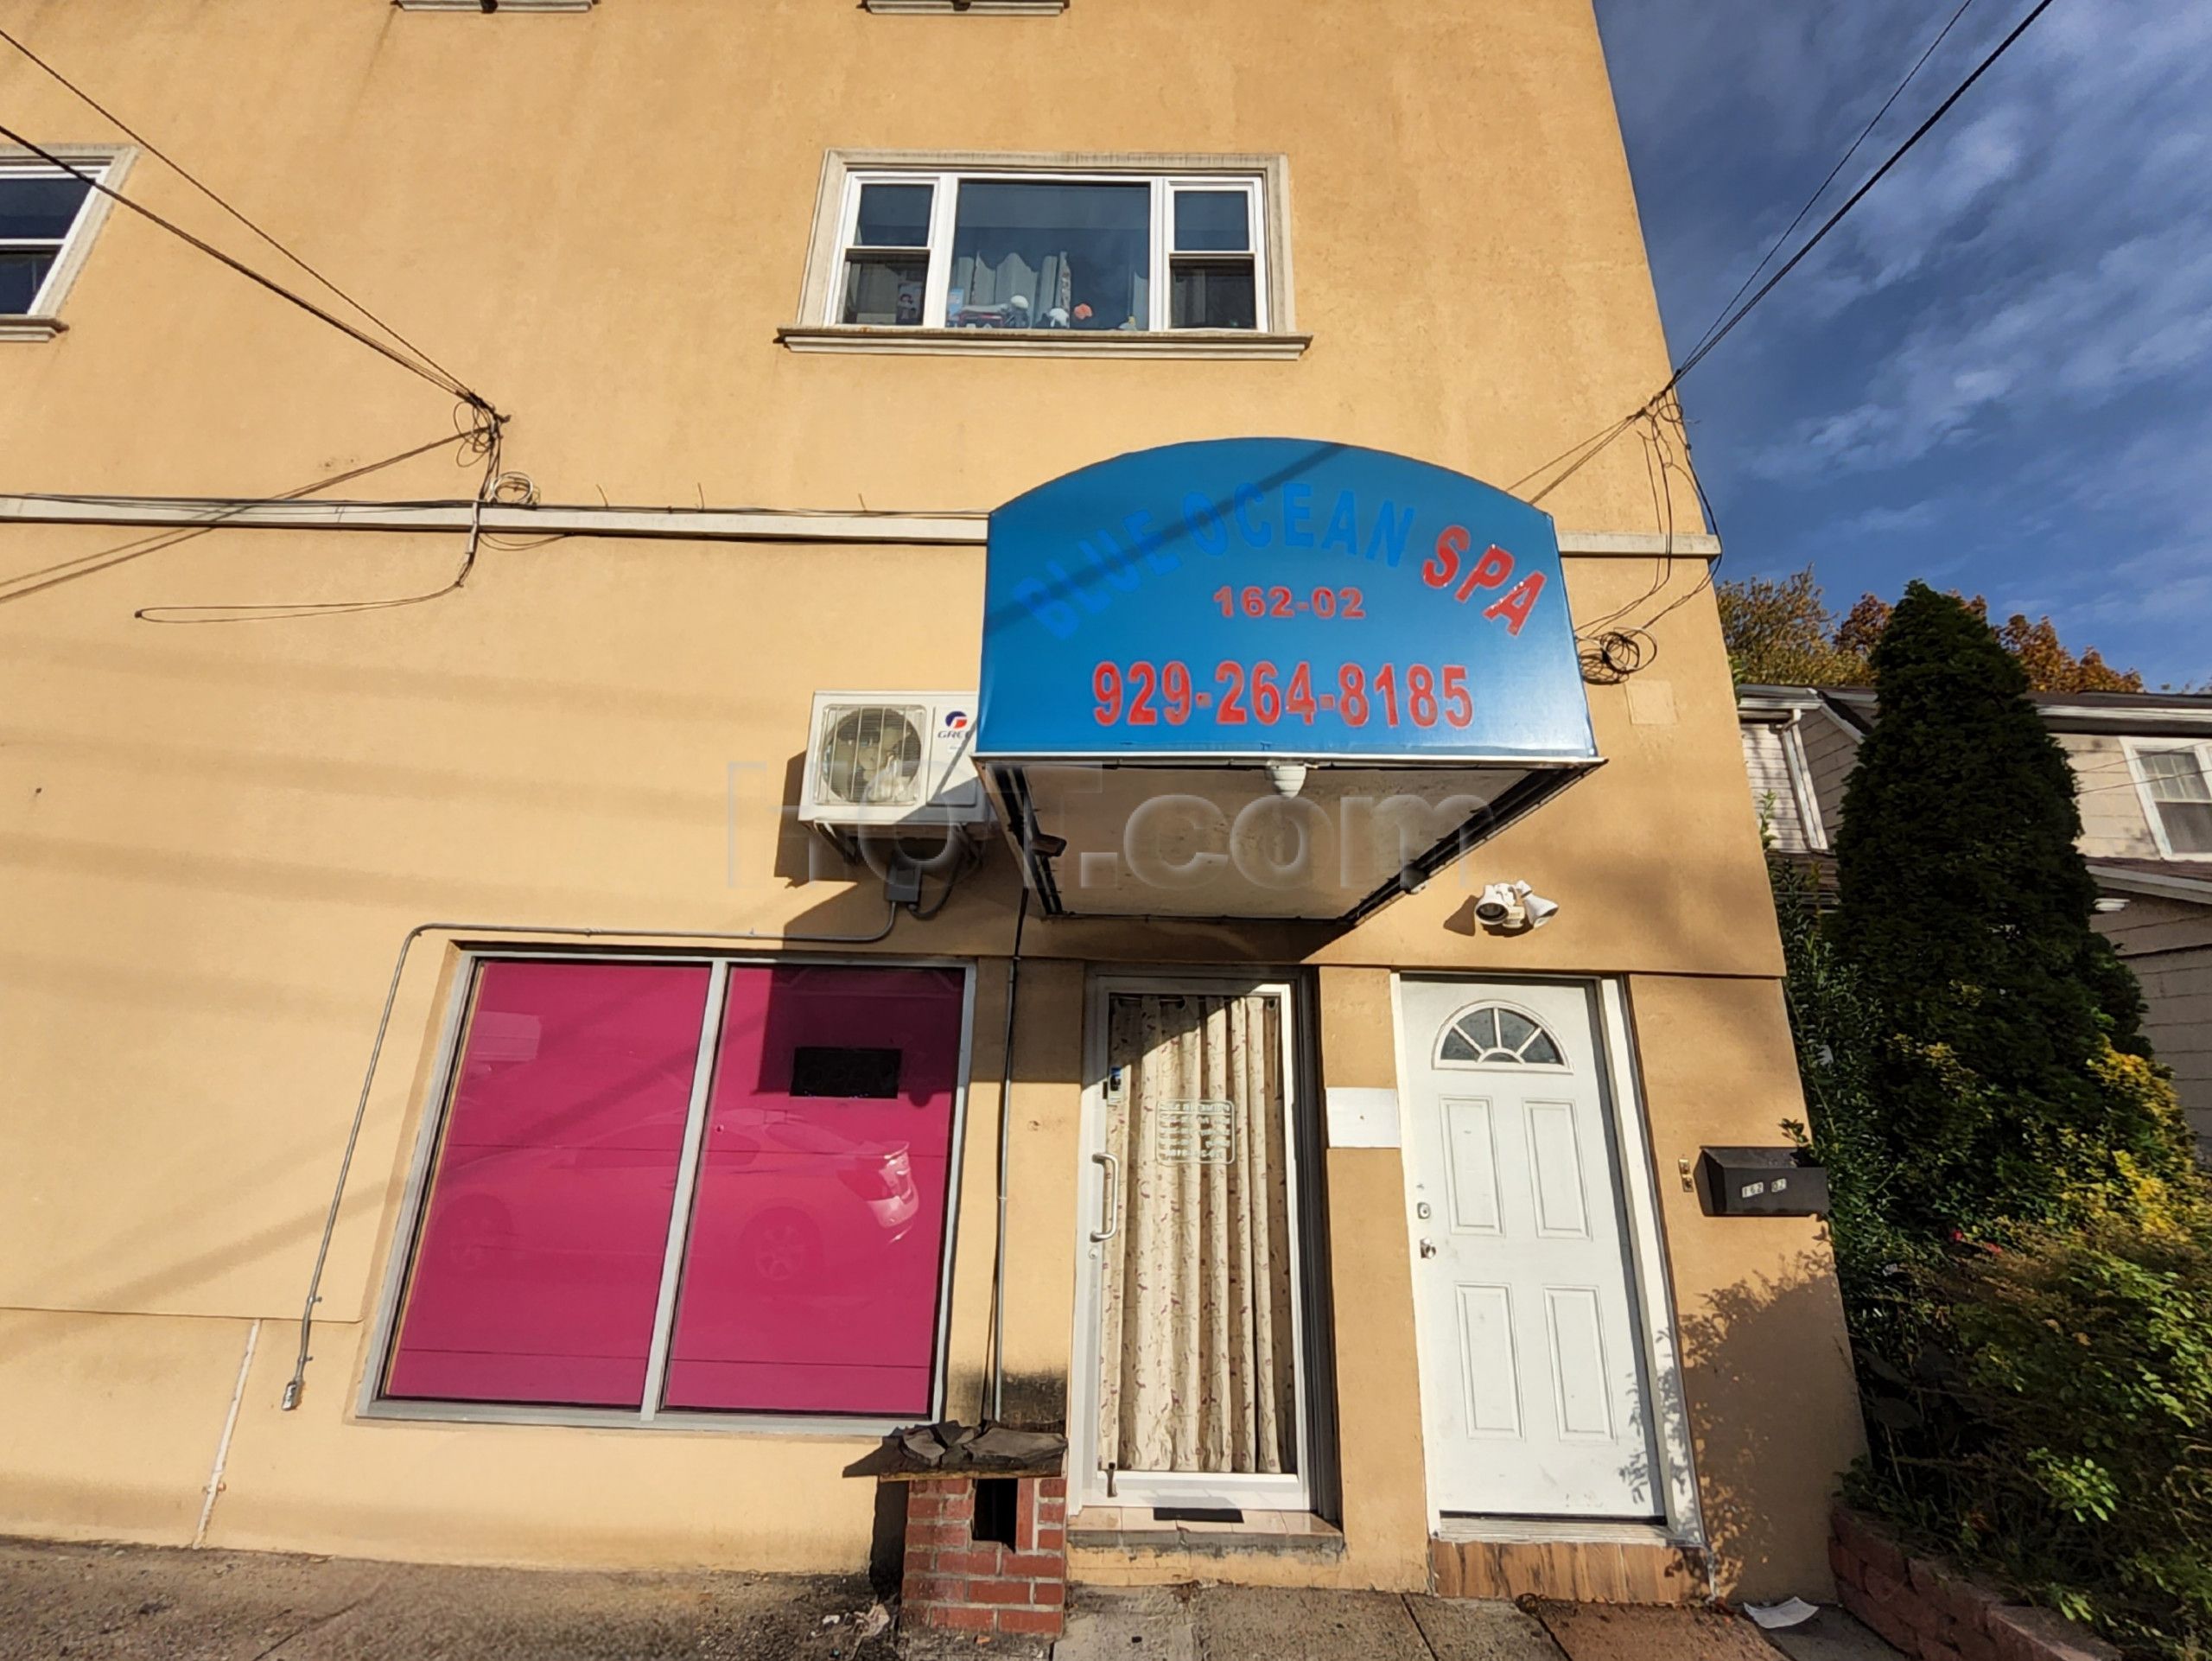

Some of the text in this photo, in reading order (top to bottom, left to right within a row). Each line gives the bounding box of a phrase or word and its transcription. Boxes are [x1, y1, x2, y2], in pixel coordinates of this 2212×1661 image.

[1014, 482, 1548, 640] BLUE OCEAN SPA
[1213, 586, 1365, 618] 162-02
[1092, 661, 1474, 728] 929-264-8185
[1743, 1183, 1763, 1196] 162
